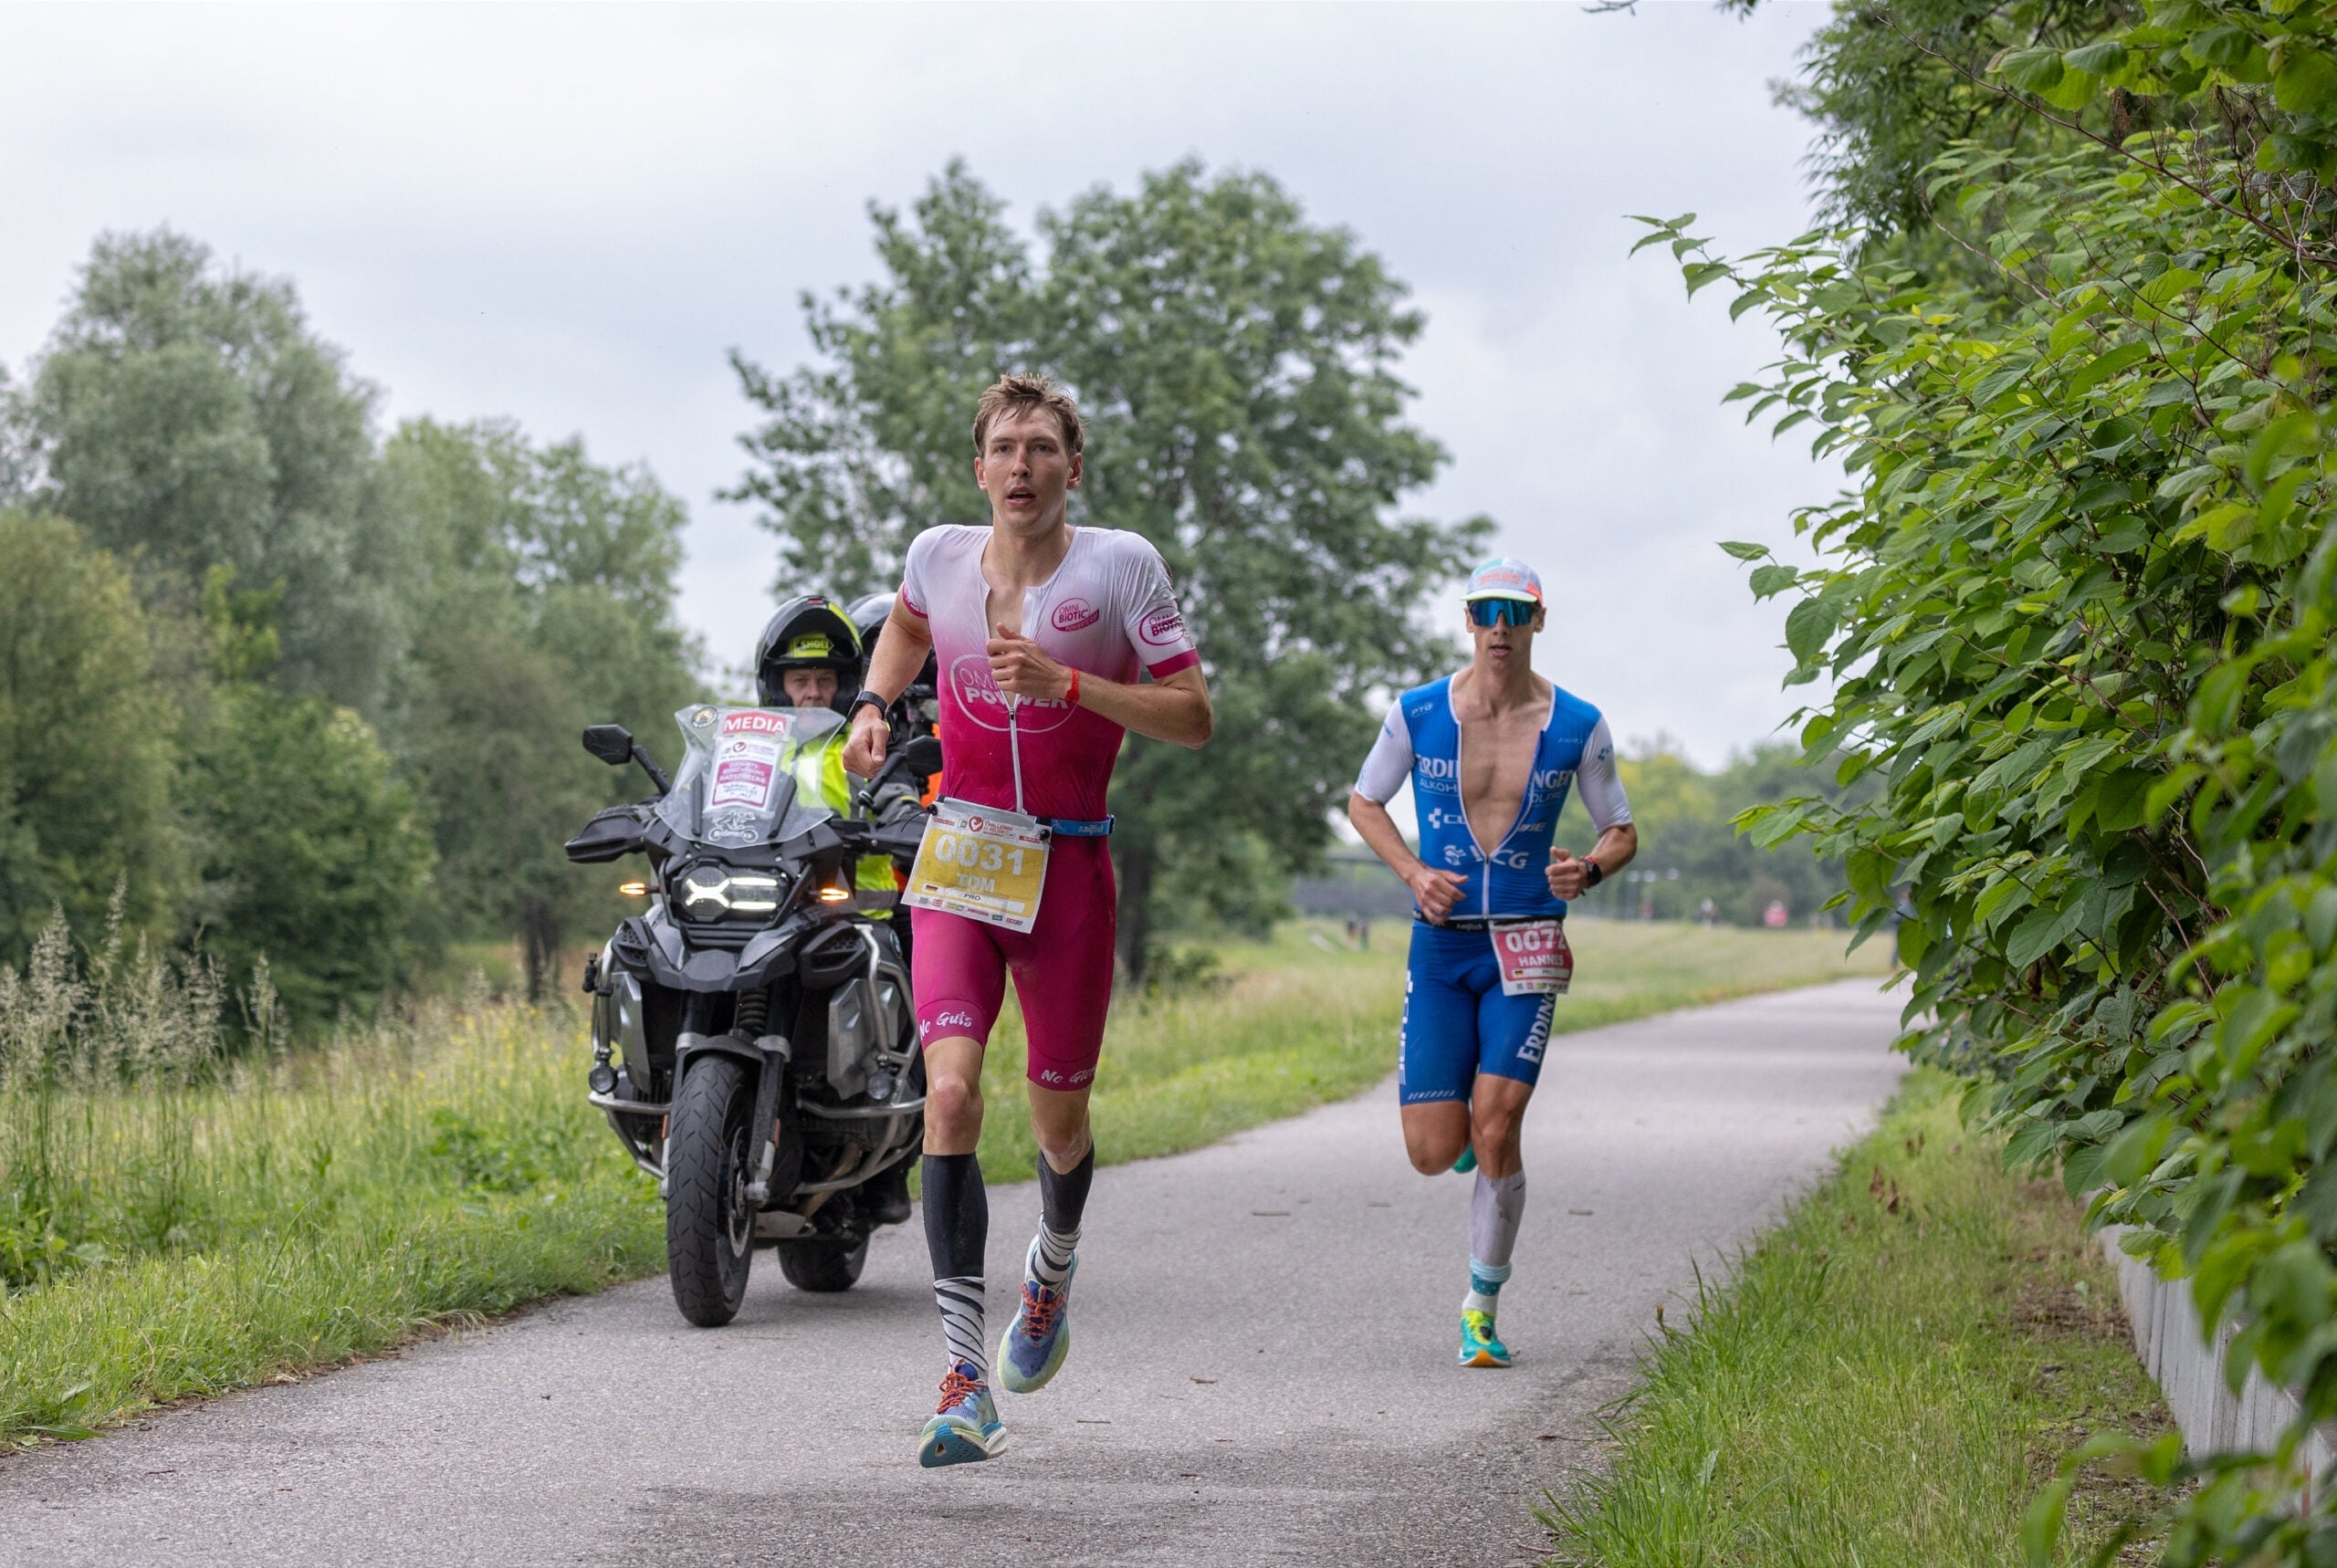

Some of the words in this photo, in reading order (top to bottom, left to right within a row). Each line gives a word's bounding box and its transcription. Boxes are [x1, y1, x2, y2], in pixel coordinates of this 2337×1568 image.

[801, 640, 829, 650] SHOEI
[724, 716, 785, 733] MEDIA
[1077, 824, 1104, 835] sailfish
[935, 834, 1023, 876] 0031
[957, 873, 995, 893] TOM
[963, 893, 981, 901] PRO
[1505, 928, 1567, 953] 0072
[1518, 955, 1565, 967] HANNES
[936, 1011, 973, 1028] Guts
